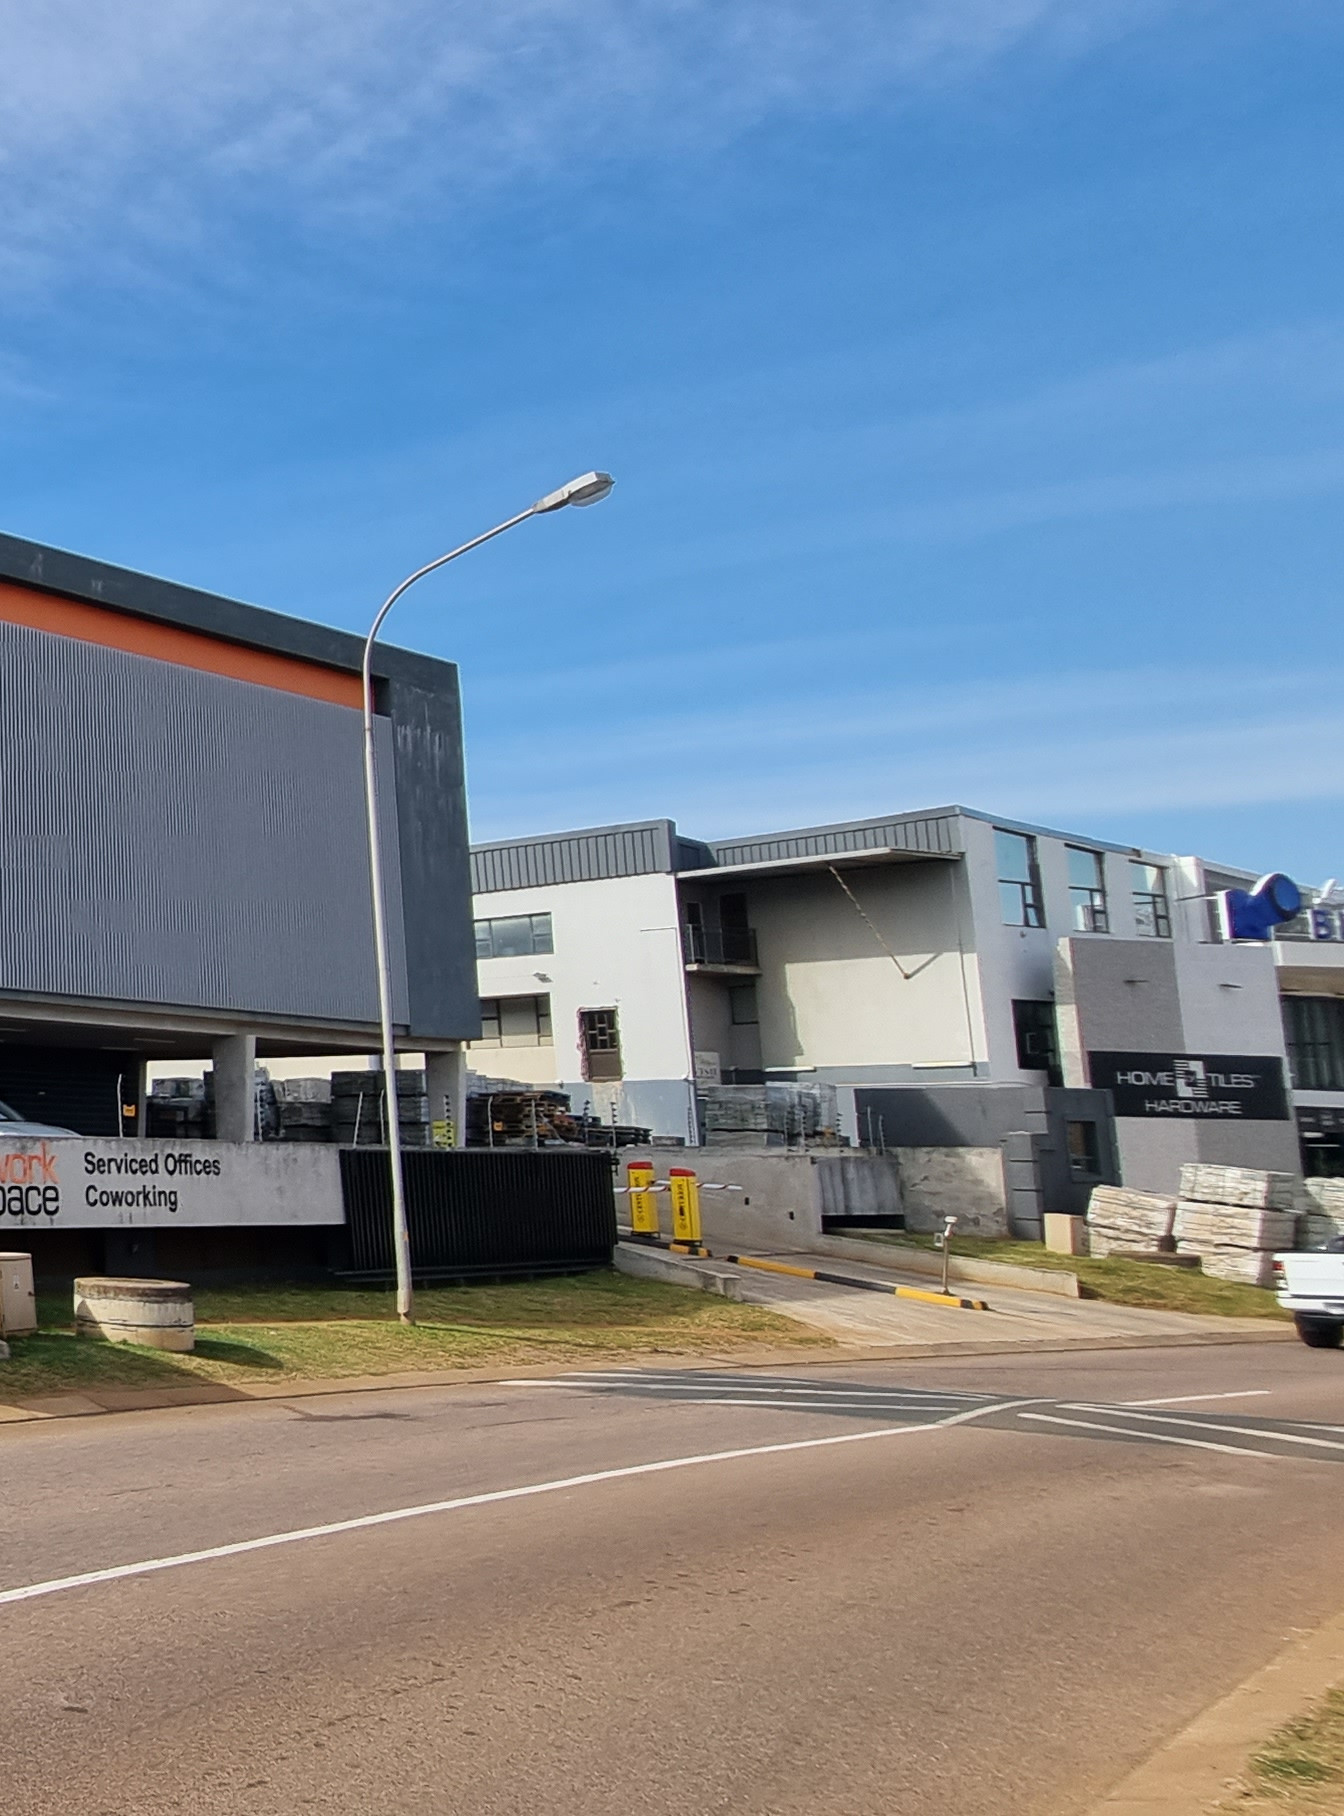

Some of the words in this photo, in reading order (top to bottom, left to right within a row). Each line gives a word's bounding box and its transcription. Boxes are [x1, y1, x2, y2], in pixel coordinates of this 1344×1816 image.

[1116, 1071, 1176, 1087] HOME
[1205, 1073, 1255, 1088] TILES
[1144, 1100, 1244, 1115] HARDWARE
[84, 1151, 159, 1175] Serviced
[164, 1152, 221, 1176] Offices
[85, 1184, 178, 1212] Coworking
